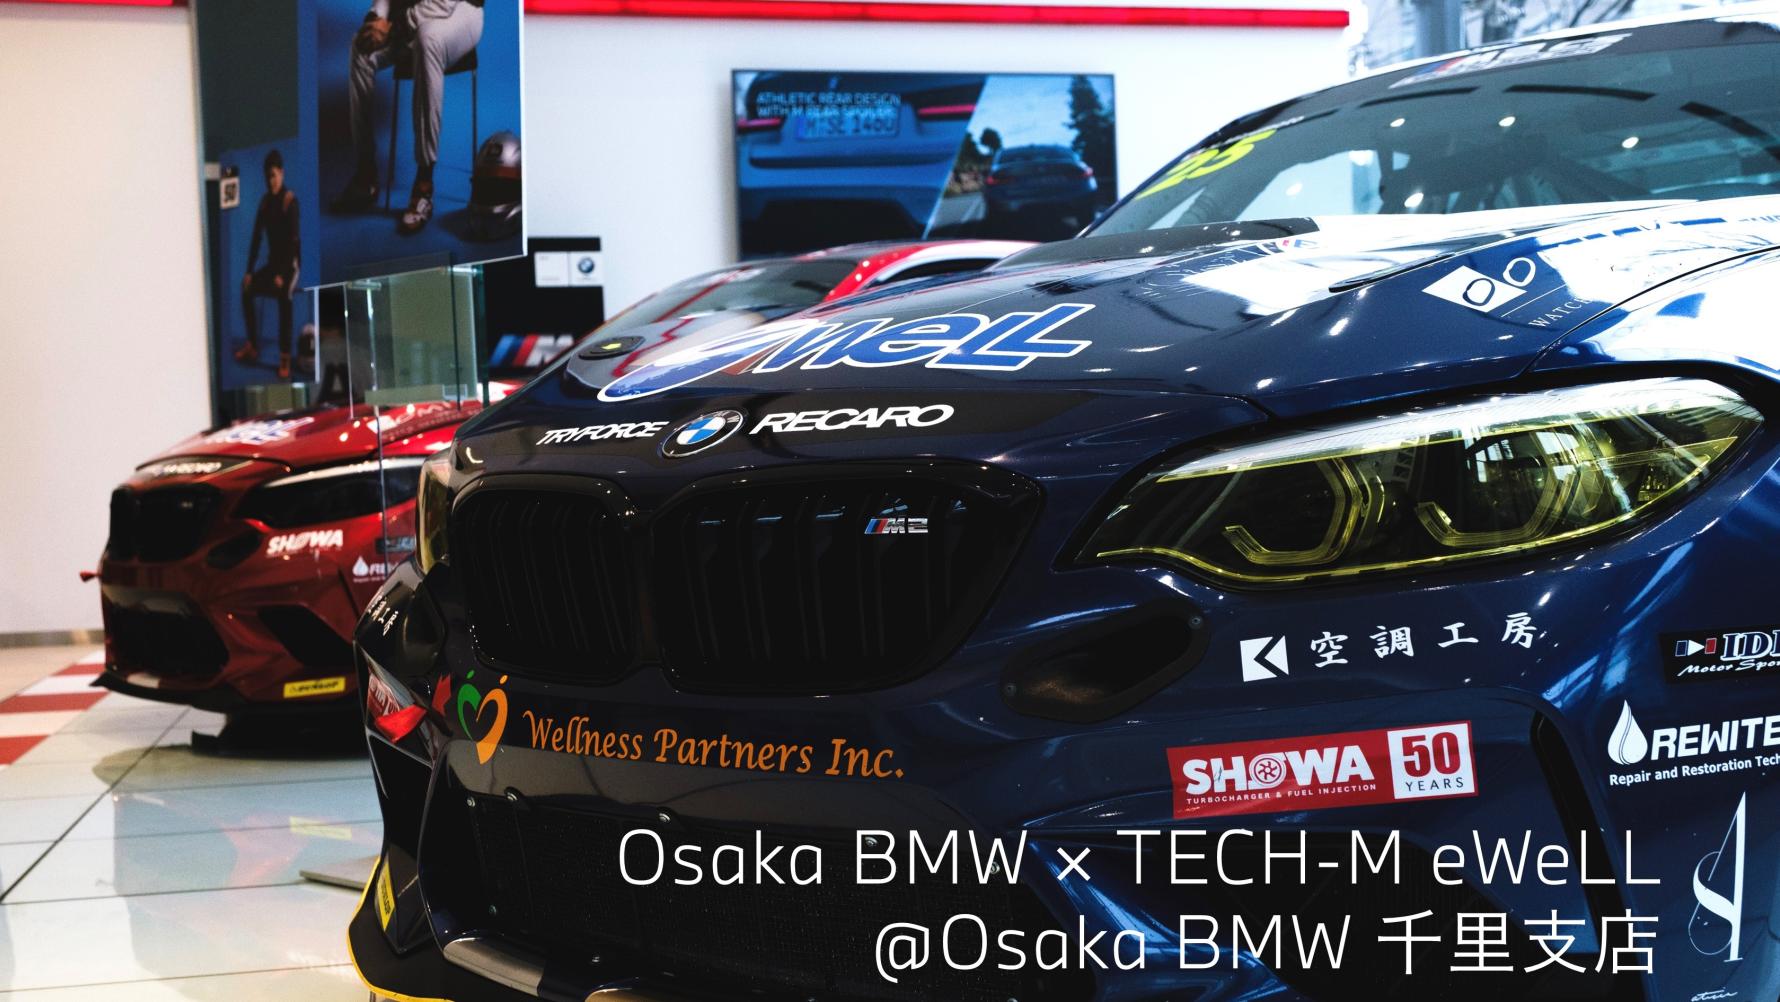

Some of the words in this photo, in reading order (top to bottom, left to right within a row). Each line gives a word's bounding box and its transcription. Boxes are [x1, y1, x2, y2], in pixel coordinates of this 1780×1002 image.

[1135, 128, 1278, 200] 25
[536, 421, 669, 446] TRYFORCE
[749, 404, 955, 435] RECARO
[1677, 664, 1734, 676] Motor
[522, 710, 643, 761] Wellness
[654, 728, 813, 774] Partners
[825, 738, 905, 778] Inc.
[1402, 732, 1462, 778] 50
[1182, 745, 1375, 795] SHOWA
[1405, 777, 1465, 792] YEARS
[1609, 771, 1651, 786] Repair
[1655, 767, 1678, 780] and
[1682, 759, 1752, 777] Restoration
[1187, 792, 1271, 804] TURBOCHARGER
[1288, 788, 1313, 797] FUEL
[1319, 784, 1376, 795] INJECTION
